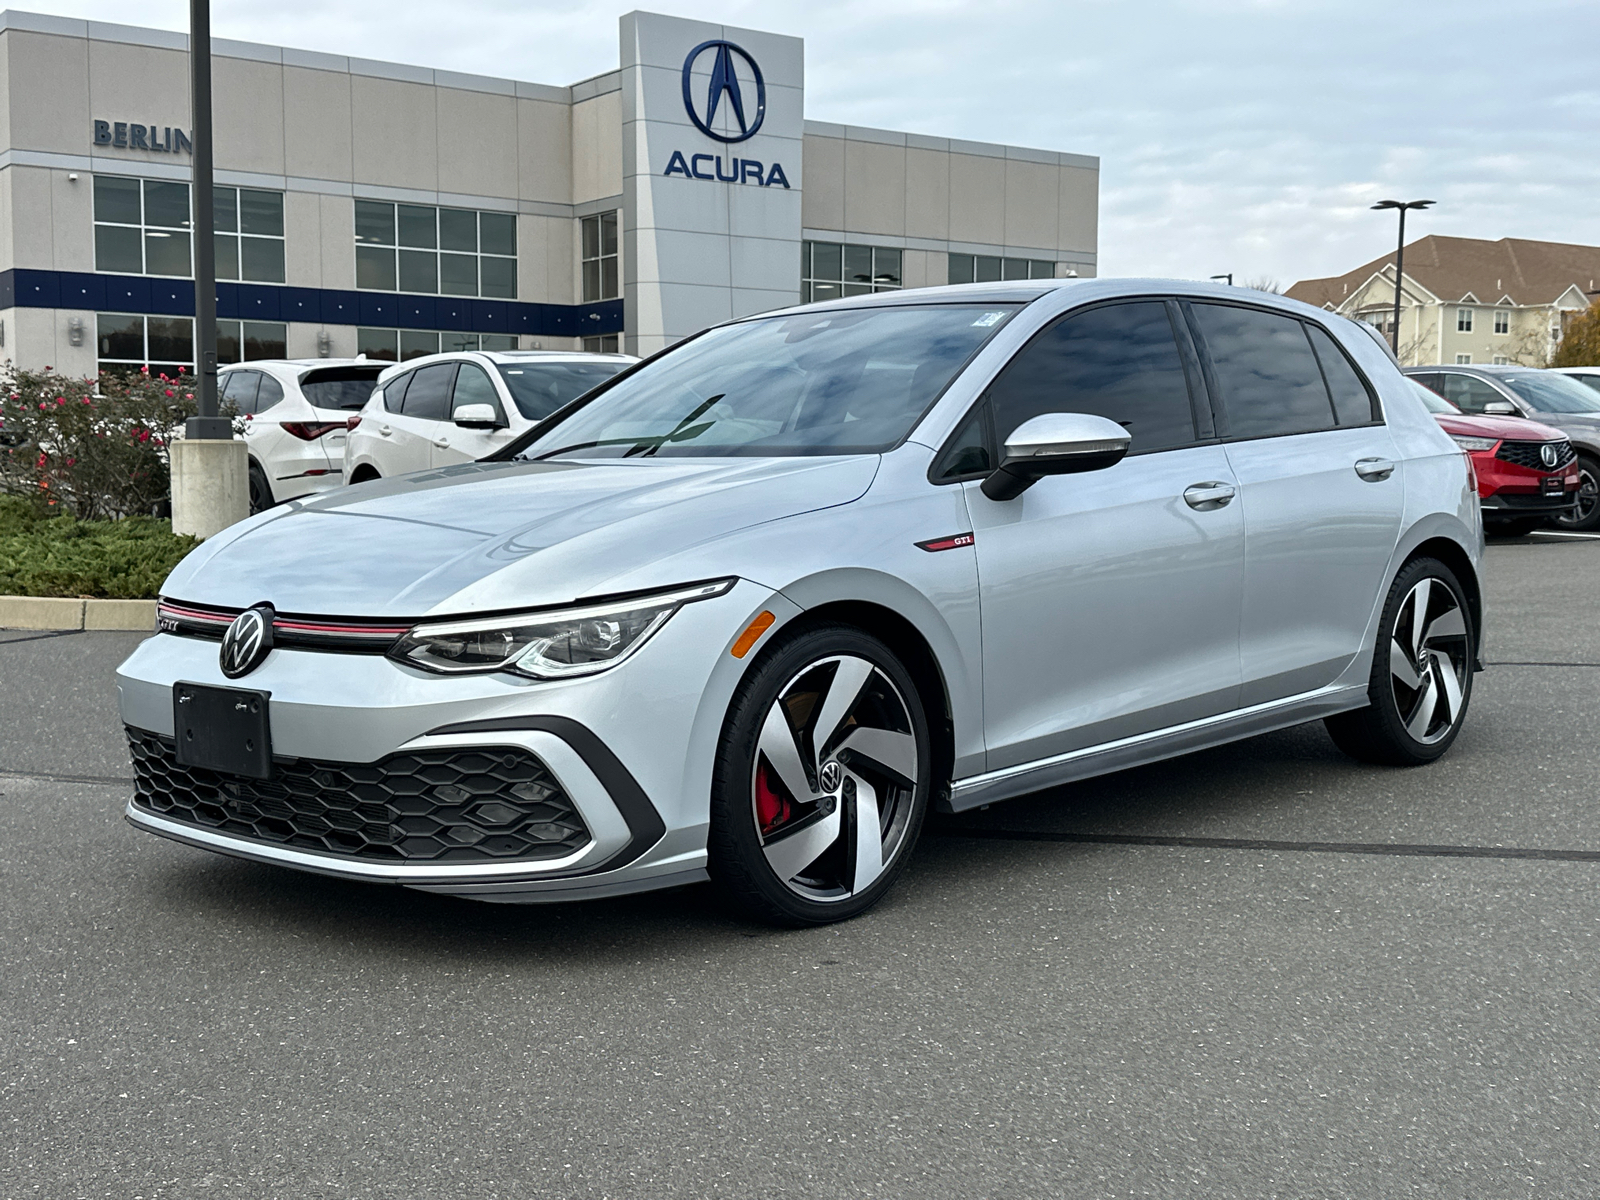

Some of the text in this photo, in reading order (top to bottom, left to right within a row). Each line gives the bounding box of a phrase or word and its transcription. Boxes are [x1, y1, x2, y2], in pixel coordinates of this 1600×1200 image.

[94, 119, 193, 155] BERLIN
[663, 150, 791, 189] ACURA
[954, 535, 971, 545] GTI
